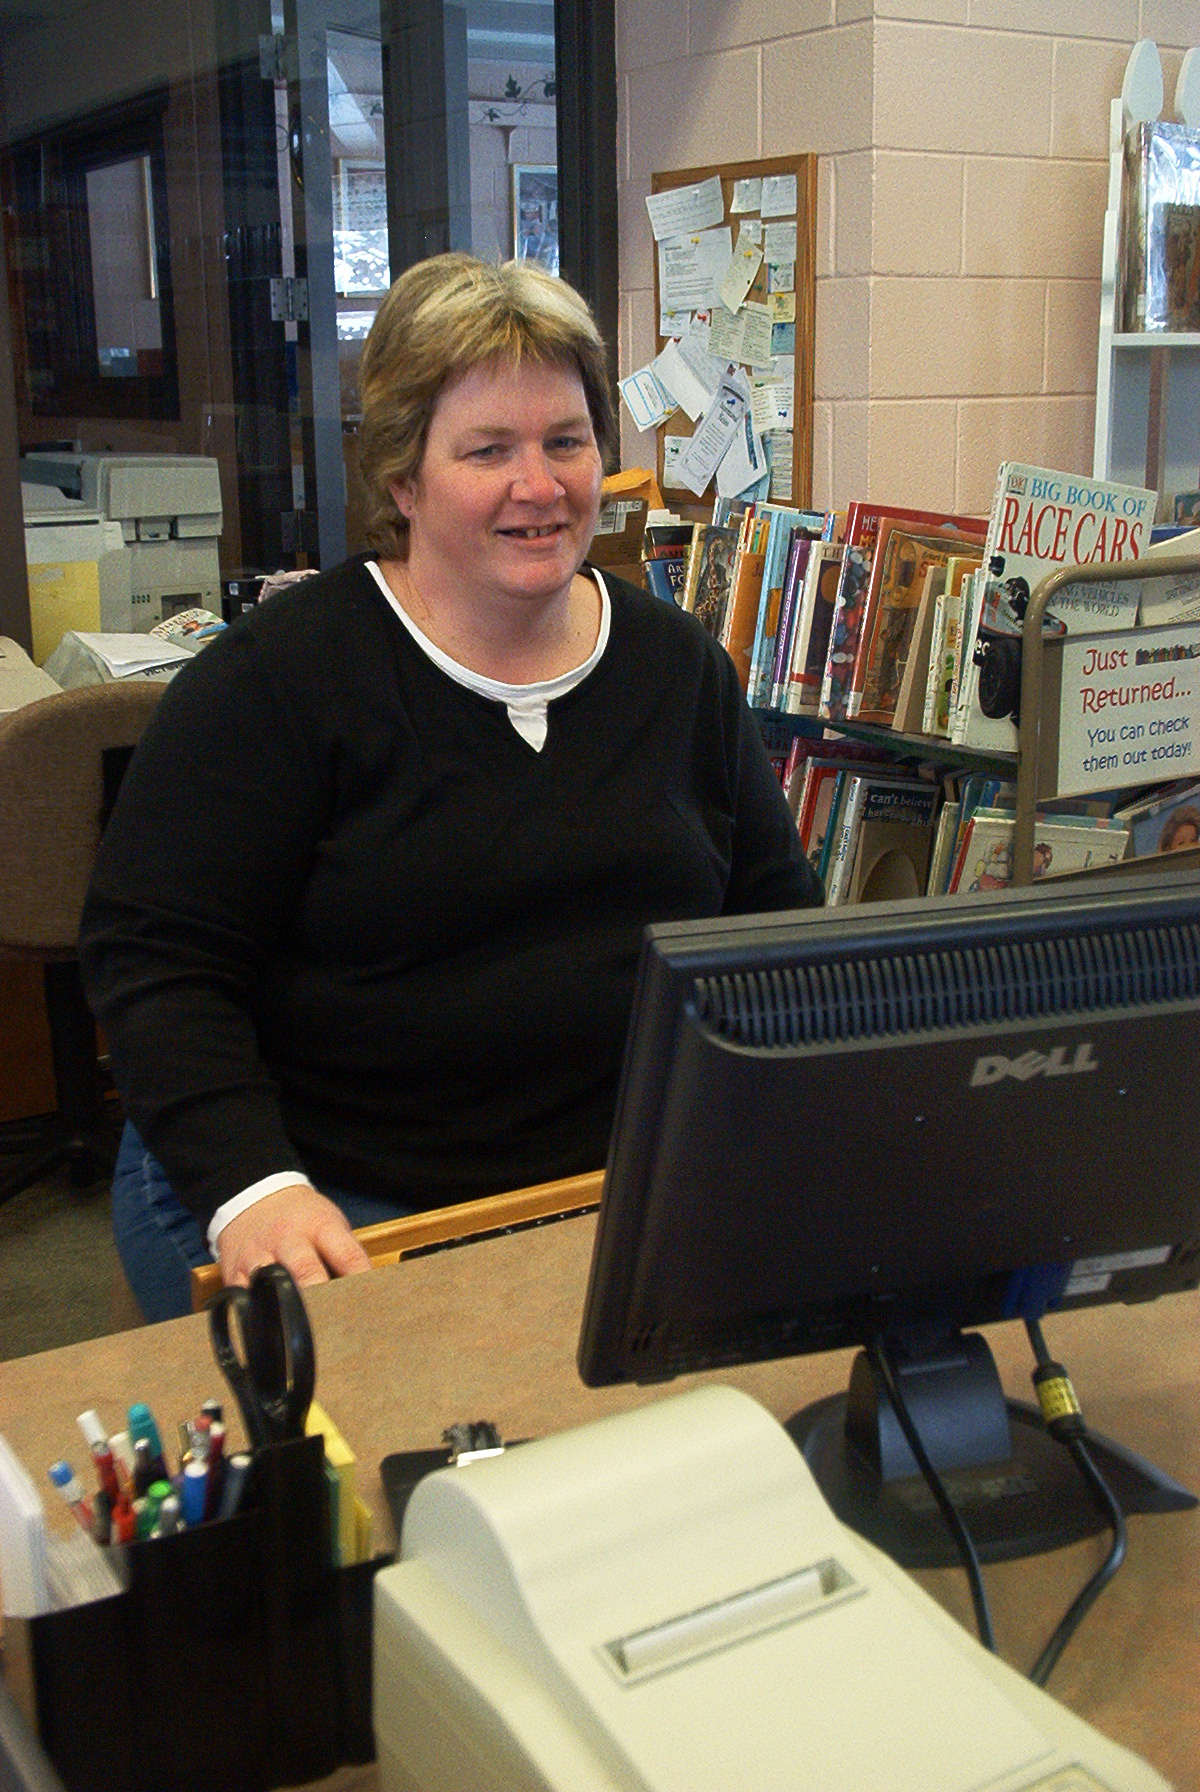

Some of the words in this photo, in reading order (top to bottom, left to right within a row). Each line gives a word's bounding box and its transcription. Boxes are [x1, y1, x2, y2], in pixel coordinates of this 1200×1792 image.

[1031, 477, 1063, 502] BIG
[1067, 485, 1118, 513] BOOK
[1123, 497, 1148, 518] OF
[996, 497, 1073, 562] RACE
[1073, 512, 1143, 565] CARS
[1082, 649, 1128, 676] Just
[1079, 677, 1192, 714] Returned...
[1087, 728, 1116, 747] You
[1082, 754, 1118, 773] them
[1123, 750, 1148, 765] out
[1151, 741, 1193, 761] today!
[969, 1043, 1099, 1088] DELL
